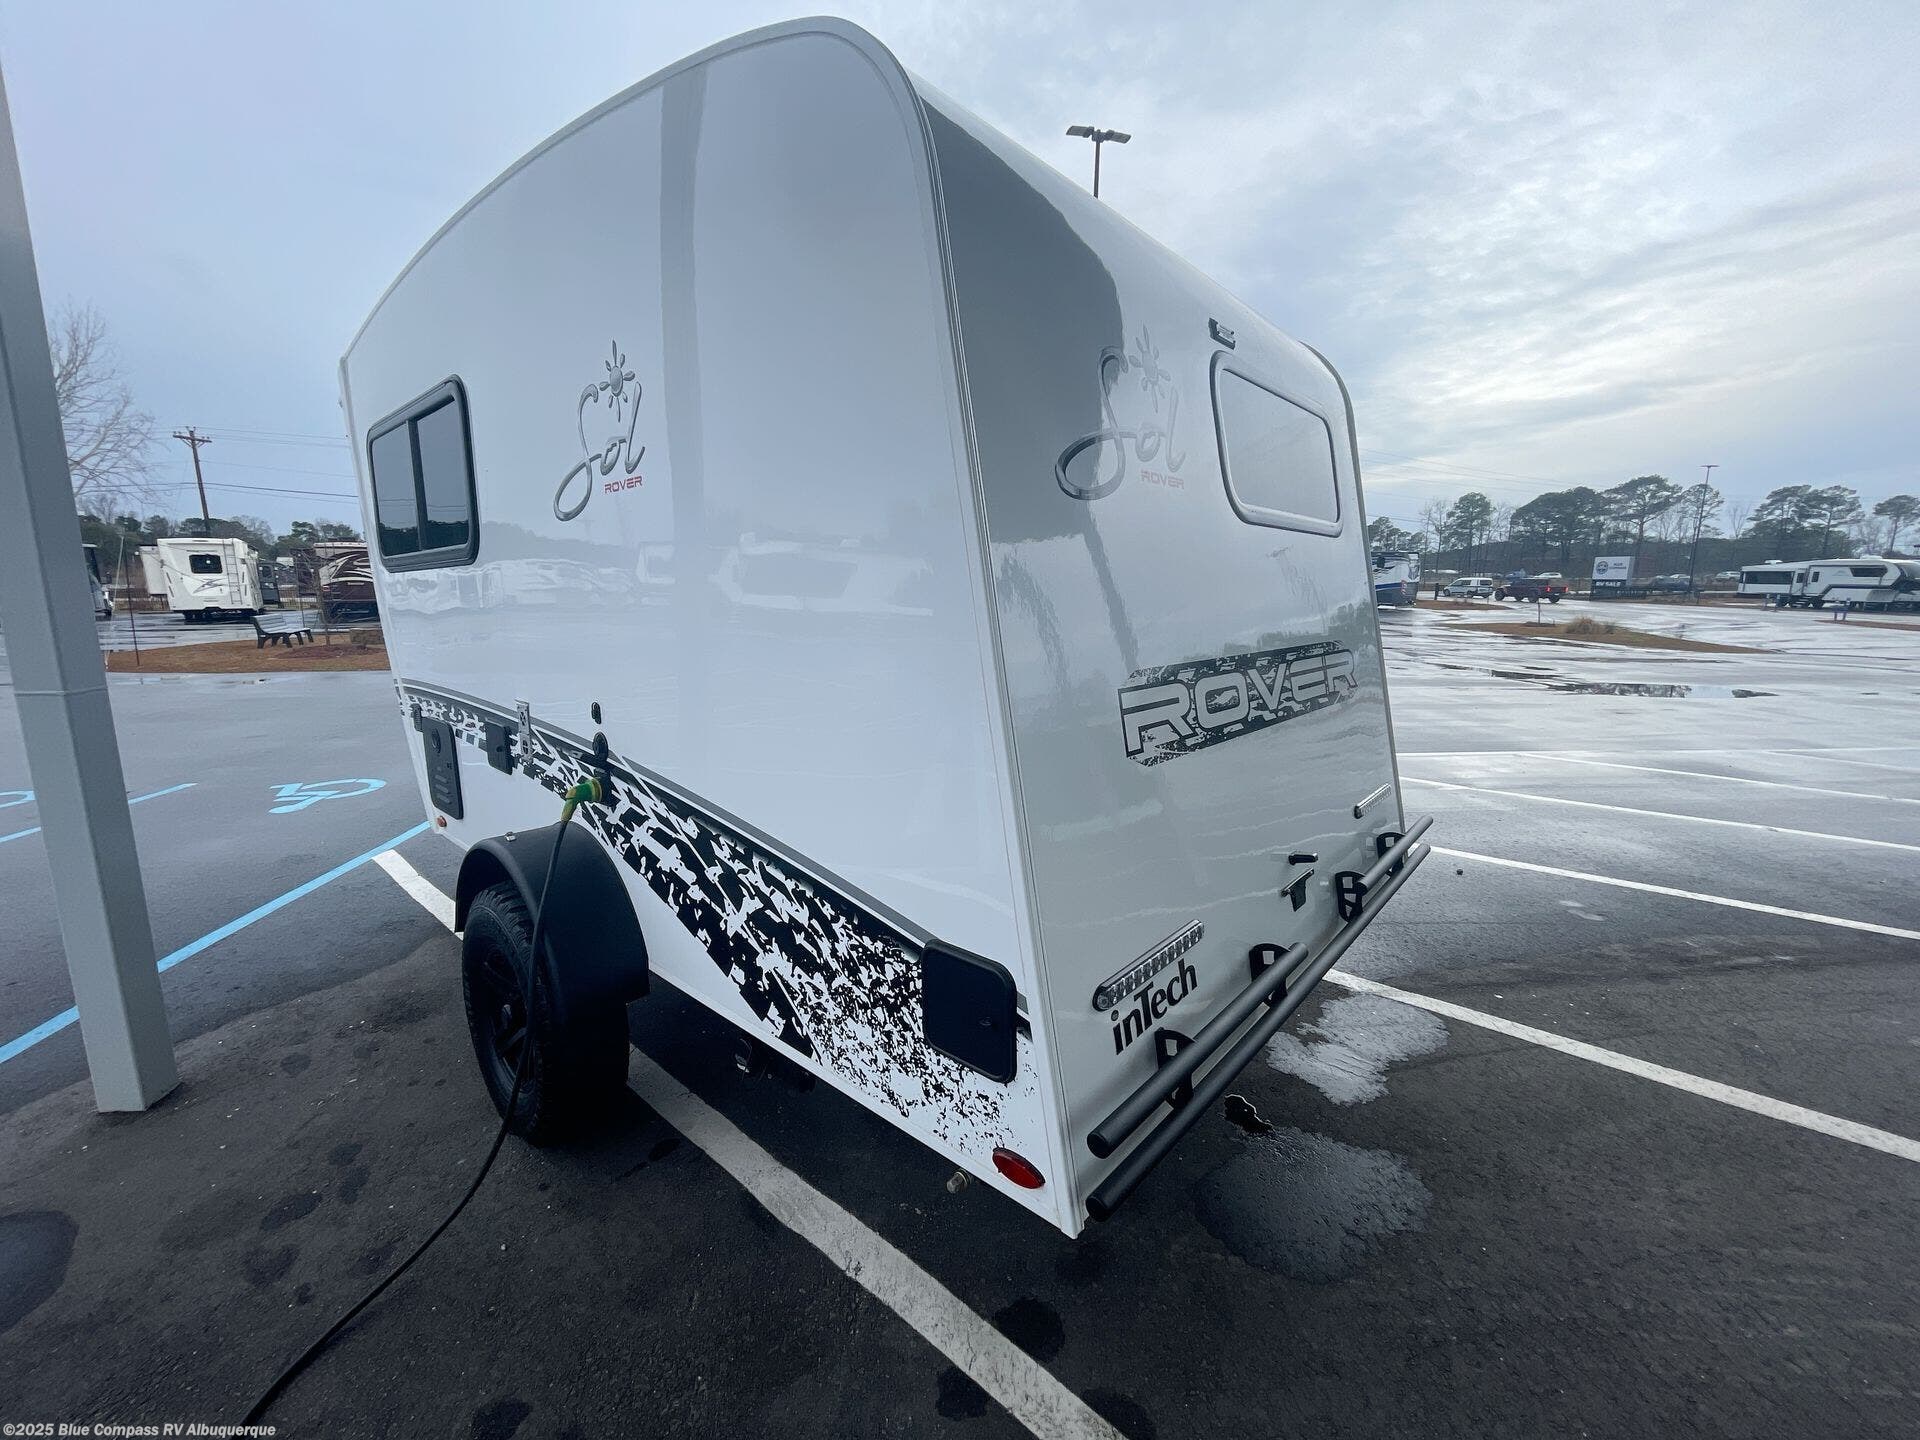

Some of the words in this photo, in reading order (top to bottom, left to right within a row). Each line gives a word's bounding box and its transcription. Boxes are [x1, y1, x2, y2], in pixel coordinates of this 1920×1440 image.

[553, 381, 646, 522] Sol
[1055, 346, 1186, 501] Sol
[604, 475, 643, 494] ROVER
[1140, 470, 1185, 490] ROVER
[1118, 648, 1358, 758] ROVER
[1111, 958, 1198, 1055] inTech
